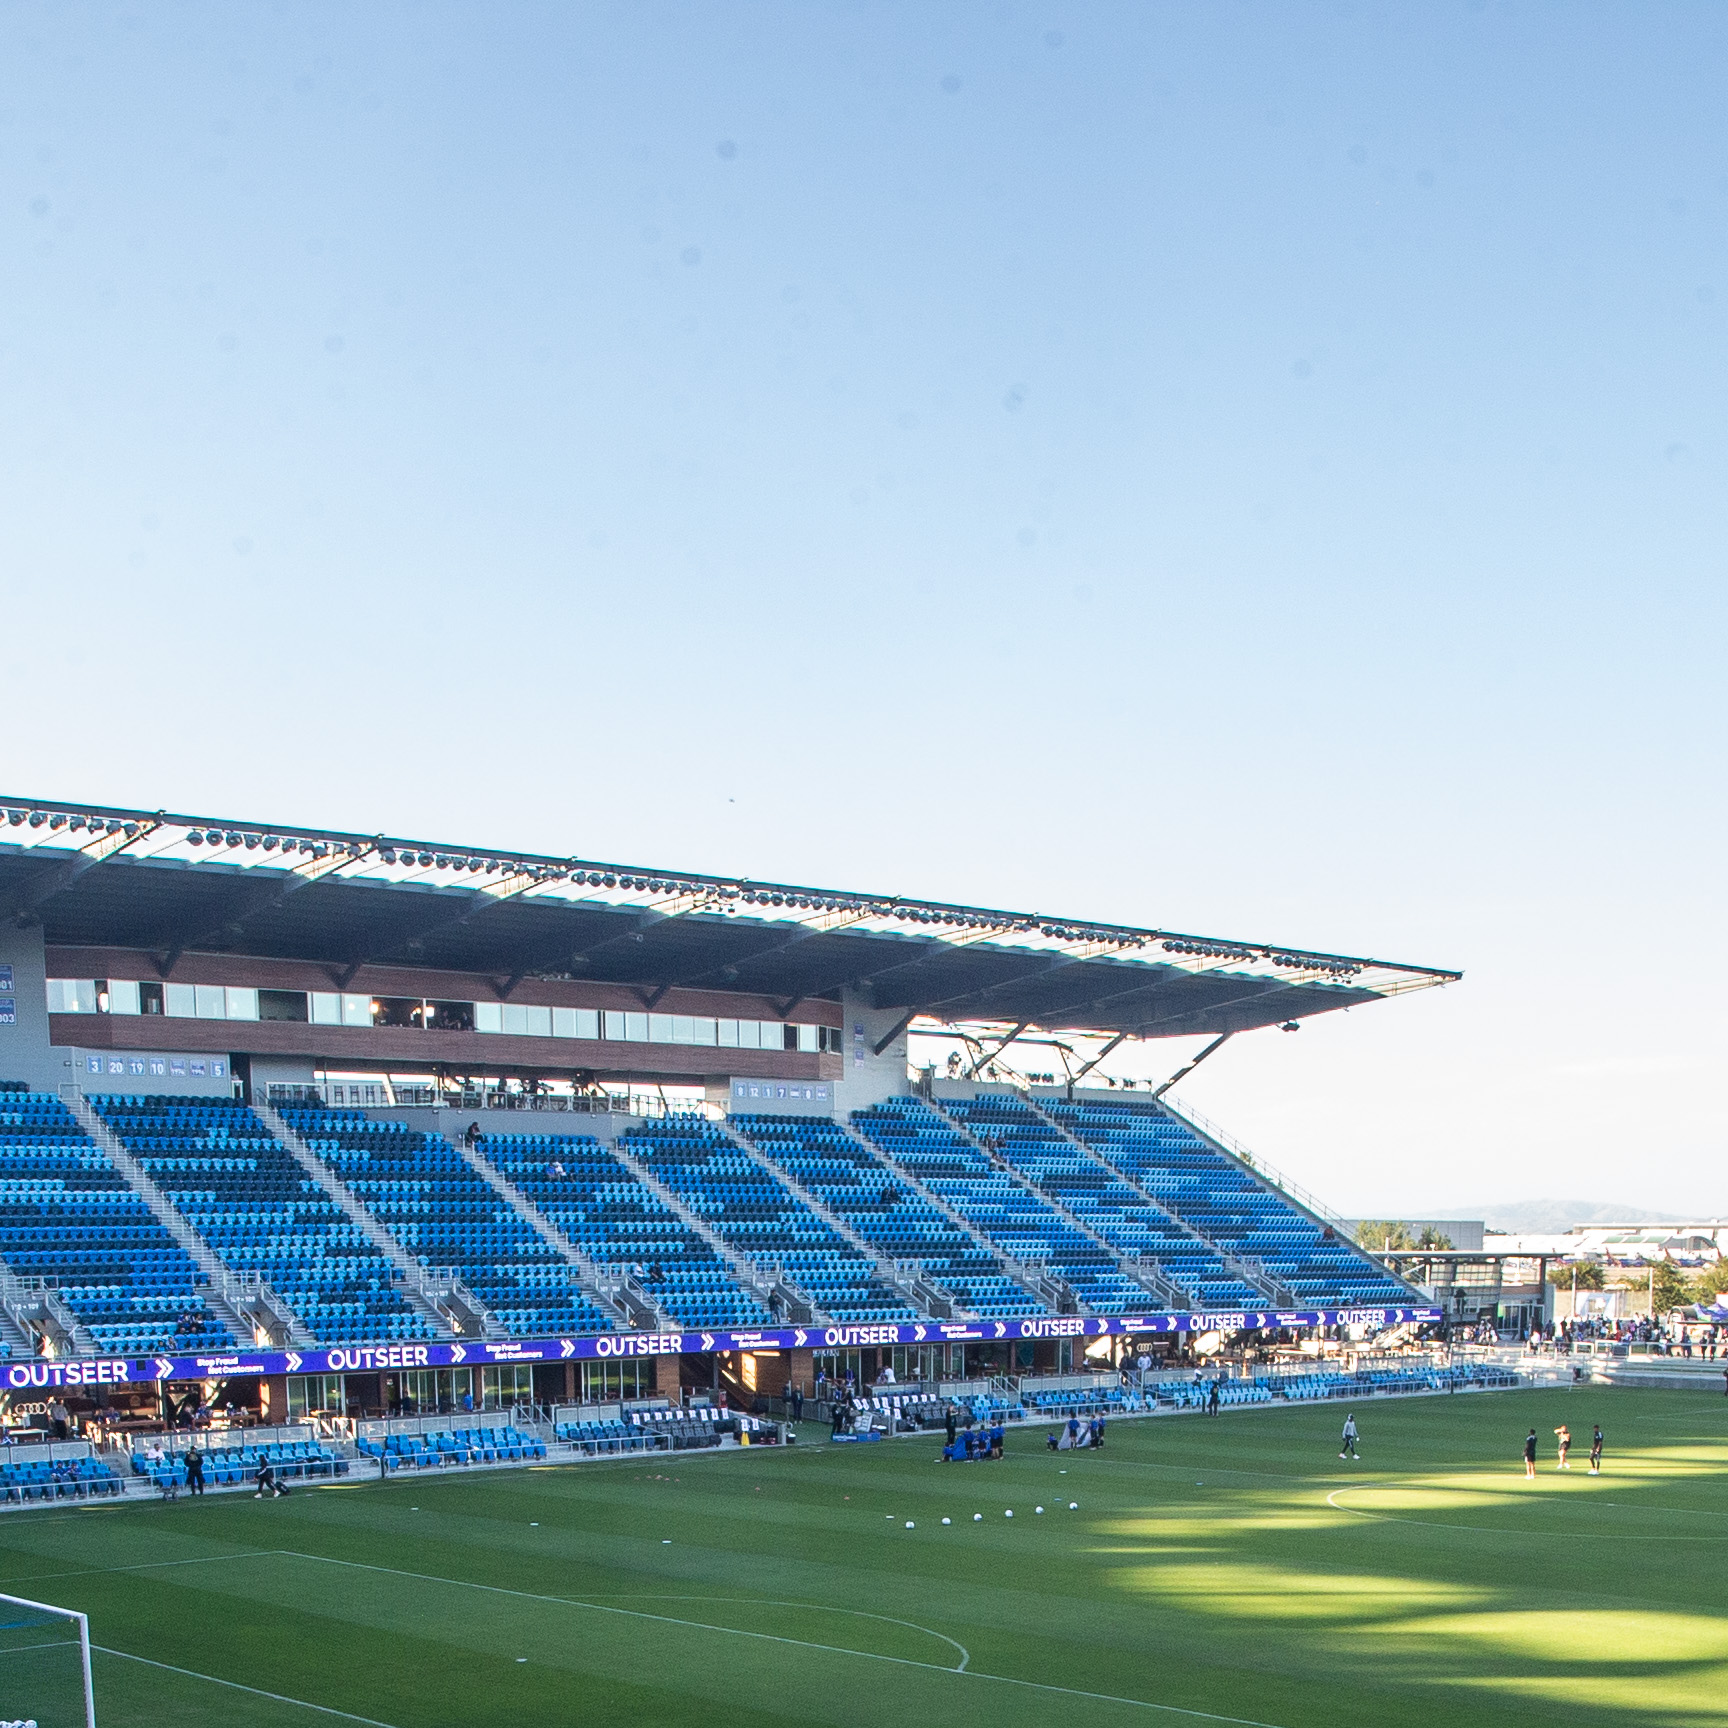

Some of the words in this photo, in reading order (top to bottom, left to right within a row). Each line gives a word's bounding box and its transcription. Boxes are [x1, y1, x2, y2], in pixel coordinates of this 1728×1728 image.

[91, 1061, 99, 1072] 3
[109, 1062, 123, 1073] 20
[131, 1062, 144, 1073] 19
[151, 1063, 164, 1075] 10
[1190, 1314, 1246, 1331] OUTSEER
[1336, 1309, 1386, 1325] OUTSEER
[825, 1326, 900, 1346] OUTSEER
[1021, 1319, 1085, 1337] OUTSEER
[596, 1334, 682, 1357] OUTSEER
[327, 1346, 428, 1370] OUTSEER
[9, 1361, 129, 1387] OUTSEER
